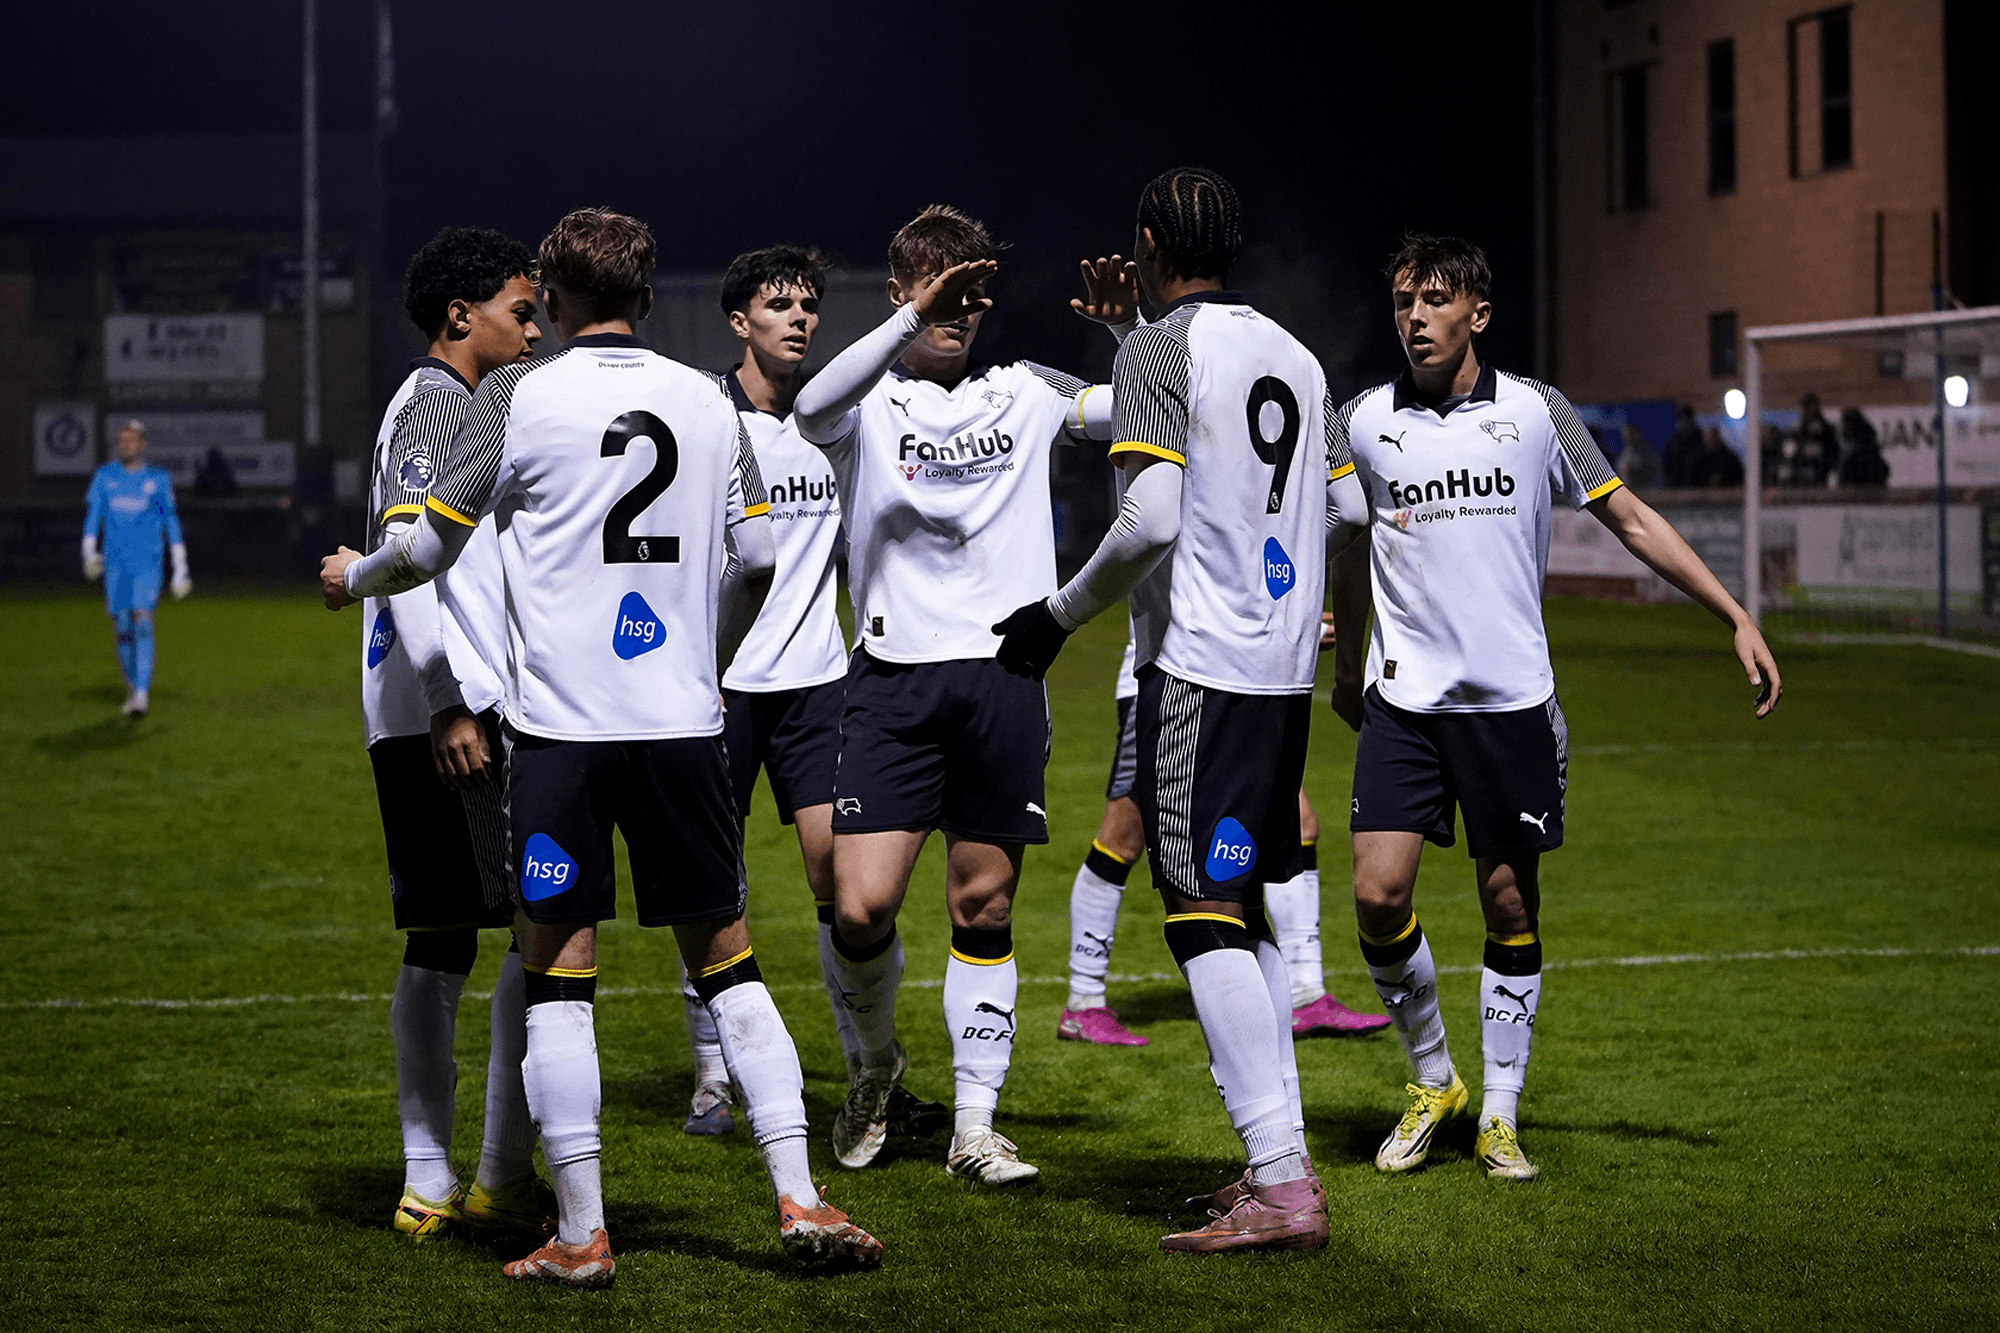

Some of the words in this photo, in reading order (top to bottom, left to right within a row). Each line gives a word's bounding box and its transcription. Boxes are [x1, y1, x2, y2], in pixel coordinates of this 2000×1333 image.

[899, 428, 1013, 461] FanHub
[1246, 375, 1300, 514] 9
[925, 467, 965, 479] Loyalty
[967, 461, 1014, 475] Rewarded
[600, 409, 680, 564] 2
[1388, 467, 1515, 509] FanHub
[769, 510, 795, 522] yalty
[1415, 508, 1455, 522] Loyalty
[1459, 505, 1517, 516] Rewarded
[1267, 559, 1290, 584] hsg
[620, 614, 656, 643] hsg
[1213, 838, 1252, 866] hsg
[525, 855, 570, 885] hsg
